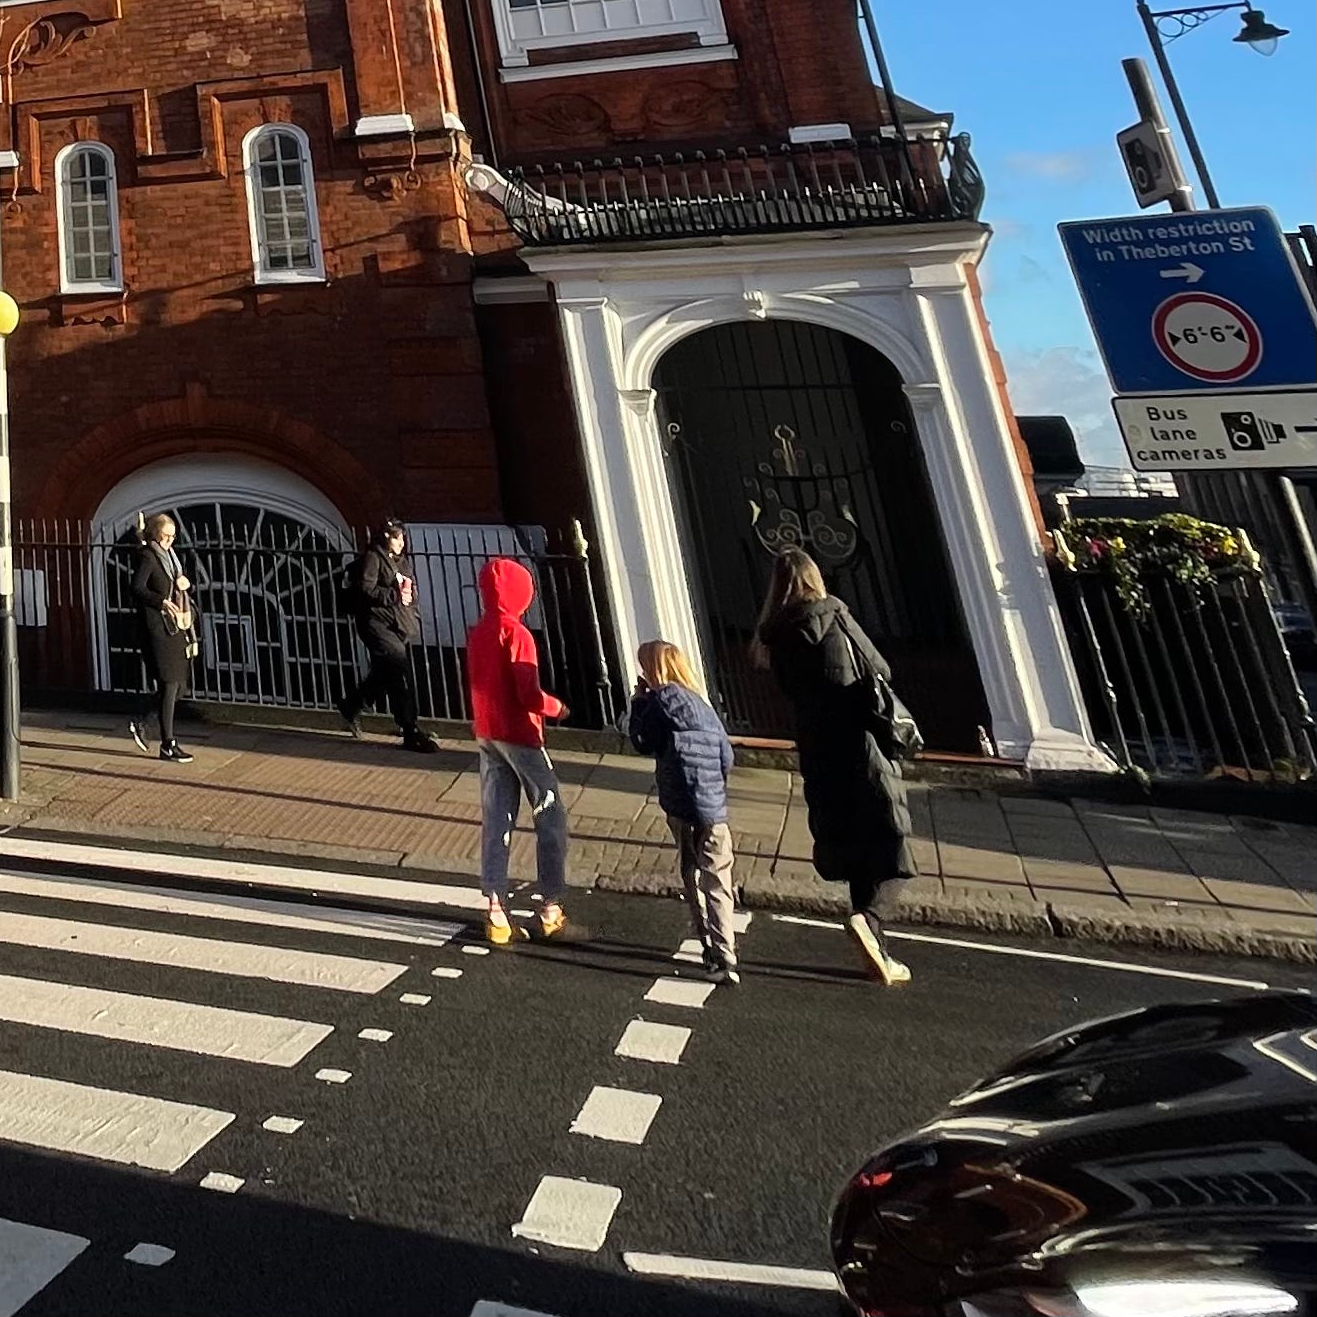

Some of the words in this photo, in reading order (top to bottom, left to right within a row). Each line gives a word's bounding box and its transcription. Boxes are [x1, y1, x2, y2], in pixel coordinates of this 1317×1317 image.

[1083, 226, 1144, 244] Width
[1147, 219, 1255, 240] restriction
[1095, 247, 1115, 262] in
[1118, 239, 1225, 261] Theberton
[1228, 236, 1256, 252] St
[1146, 406, 1188, 422] Bus
[1150, 426, 1197, 442] lane
[1136, 446, 1227, 462] cameras
